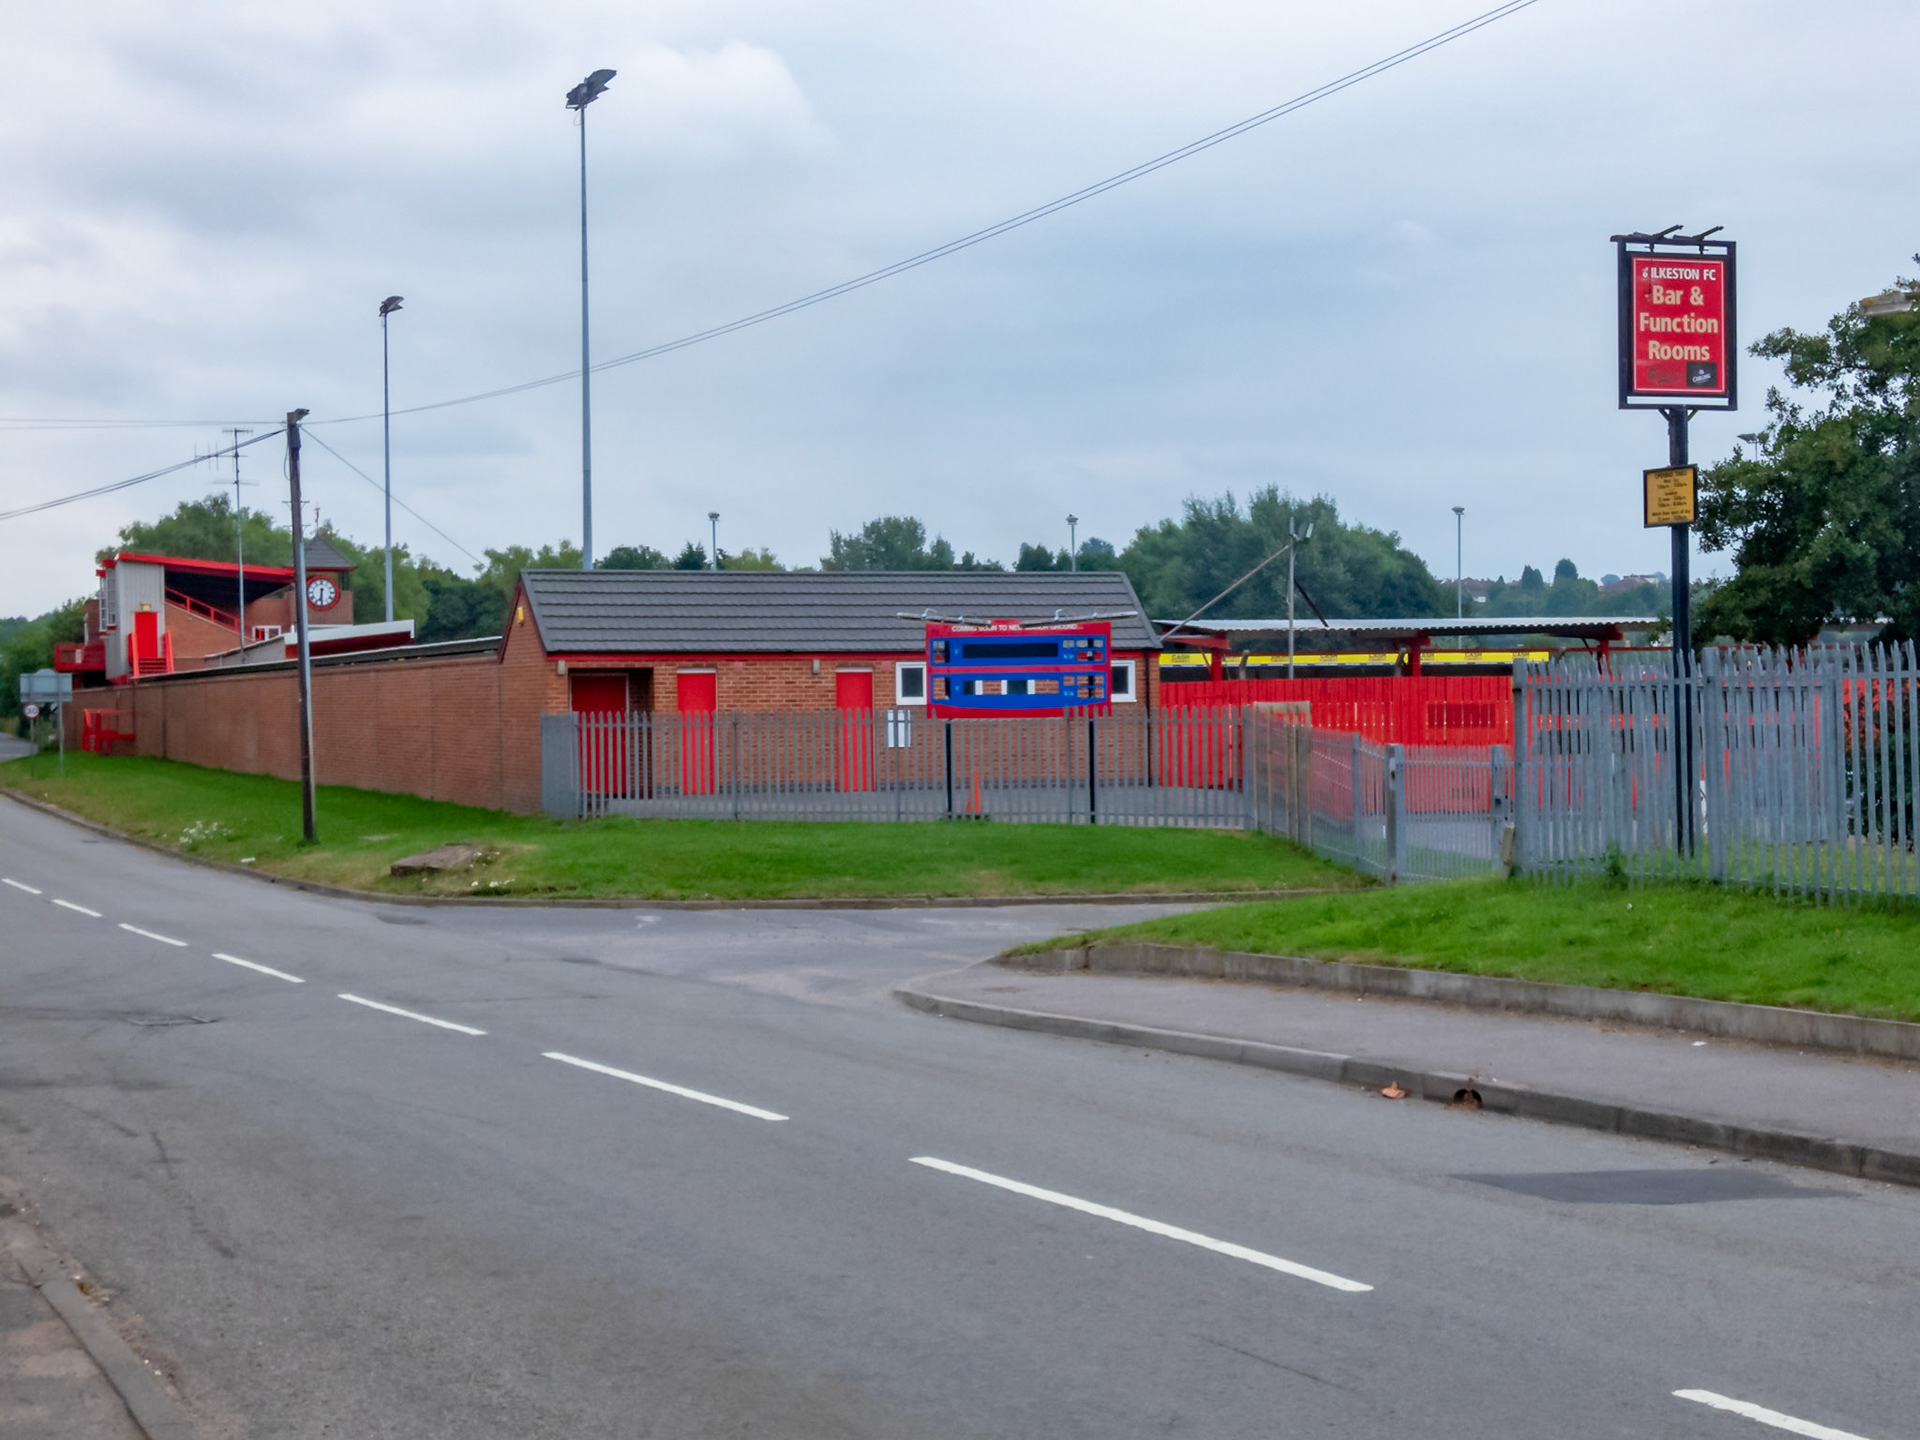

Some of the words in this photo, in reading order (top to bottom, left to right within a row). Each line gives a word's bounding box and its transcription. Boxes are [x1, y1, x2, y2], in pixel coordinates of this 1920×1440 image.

[1650, 267, 1700, 281] ILKESTON
[1703, 269, 1717, 281] FC
[1652, 285, 1684, 305] Bar
[1689, 286, 1705, 306] &
[1639, 312, 1719, 334] Function
[1648, 340, 1711, 361] Rooms
